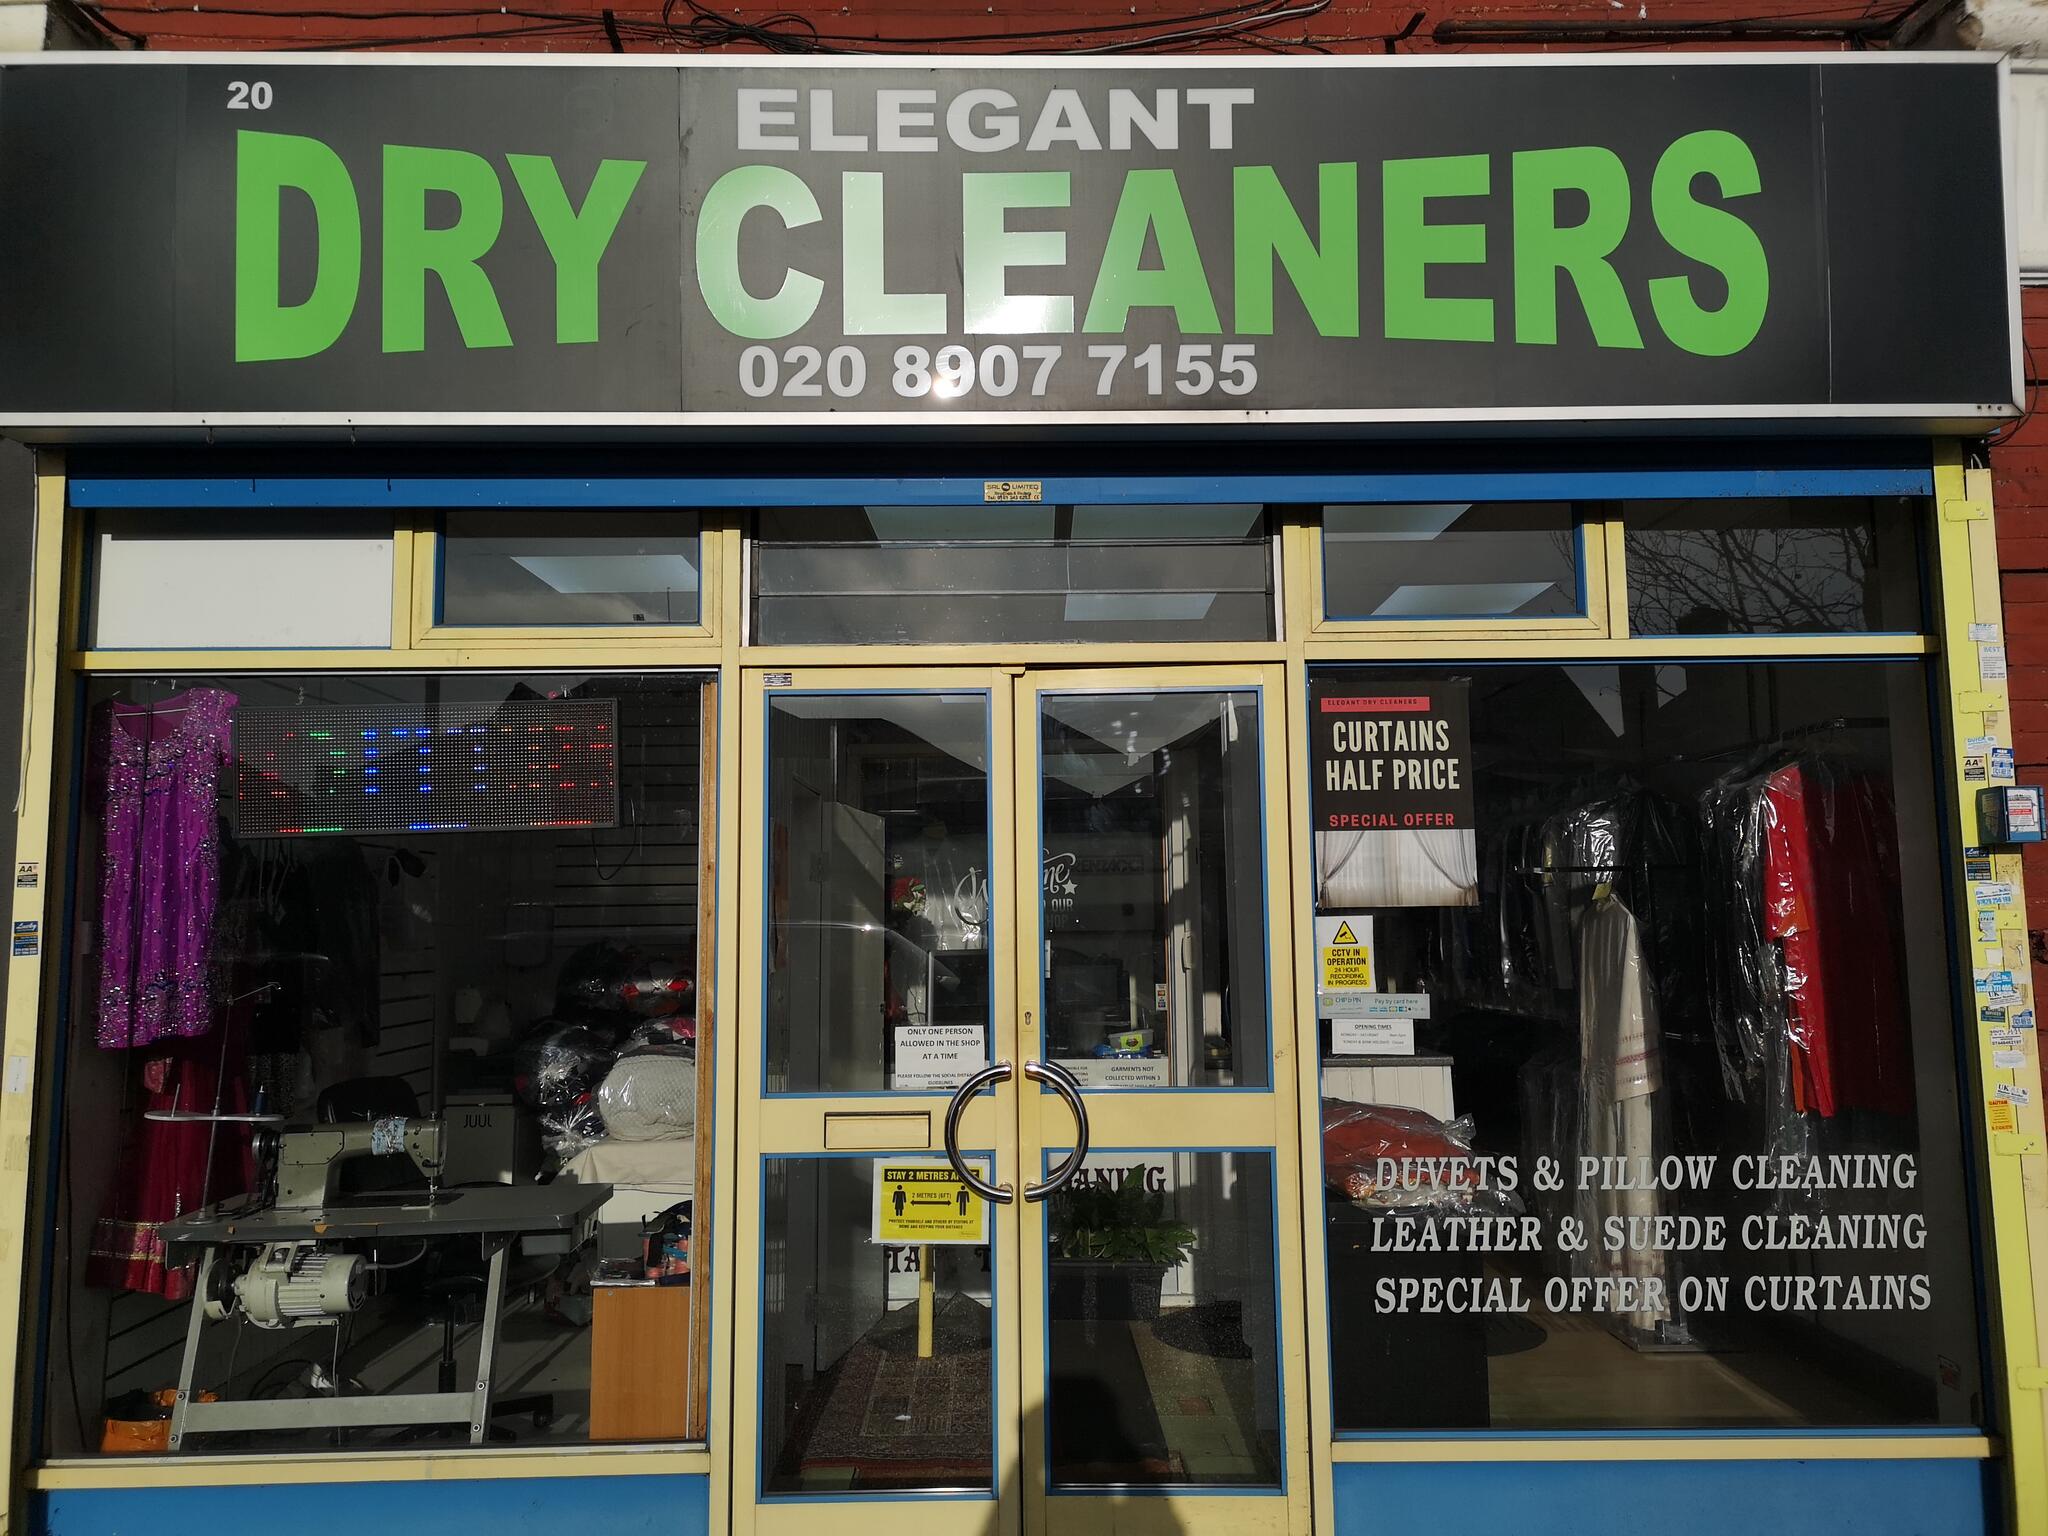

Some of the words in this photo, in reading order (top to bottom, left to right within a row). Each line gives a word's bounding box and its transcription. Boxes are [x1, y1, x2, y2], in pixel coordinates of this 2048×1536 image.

[227, 81, 273, 110] 20
[737, 88, 1255, 152] ELEGANT
[235, 129, 648, 362] DRY
[695, 129, 1770, 356] CLEANERS
[738, 346, 866, 397] 020
[892, 345, 1062, 397] 8907
[1088, 344, 1258, 395] 7155
[1332, 720, 1450, 753] CURTAINS
[1326, 759, 1384, 791] HALF
[1392, 758, 1461, 790] PRICE
[1329, 814, 1398, 827] SPECIAL
[1403, 813, 1455, 826] OFFER
[1051, 898, 1073, 912] OUR
[1327, 958, 1367, 966] OPERATION
[1332, 949, 1351, 957] CCTV
[887, 1171, 907, 1180] STAY
[908, 1171, 914, 1180] 2
[916, 1171, 949, 1180] METRES
[1375, 1156, 1518, 1191] DUVETS
[1533, 1156, 1565, 1191] &
[1578, 1155, 1719, 1190] PILLOW
[1732, 1153, 1918, 1190] CLEANING
[1370, 1217, 1543, 1252] LEATHER
[1557, 1216, 1589, 1252] &
[1603, 1216, 1727, 1251] SUEDE
[1741, 1213, 1928, 1250] CLEANING
[1374, 1277, 1532, 1314] SPECIAL
[1544, 1277, 1665, 1313] OFFER
[1679, 1276, 1728, 1313] ON
[1744, 1274, 1932, 1313] CURTAINS
